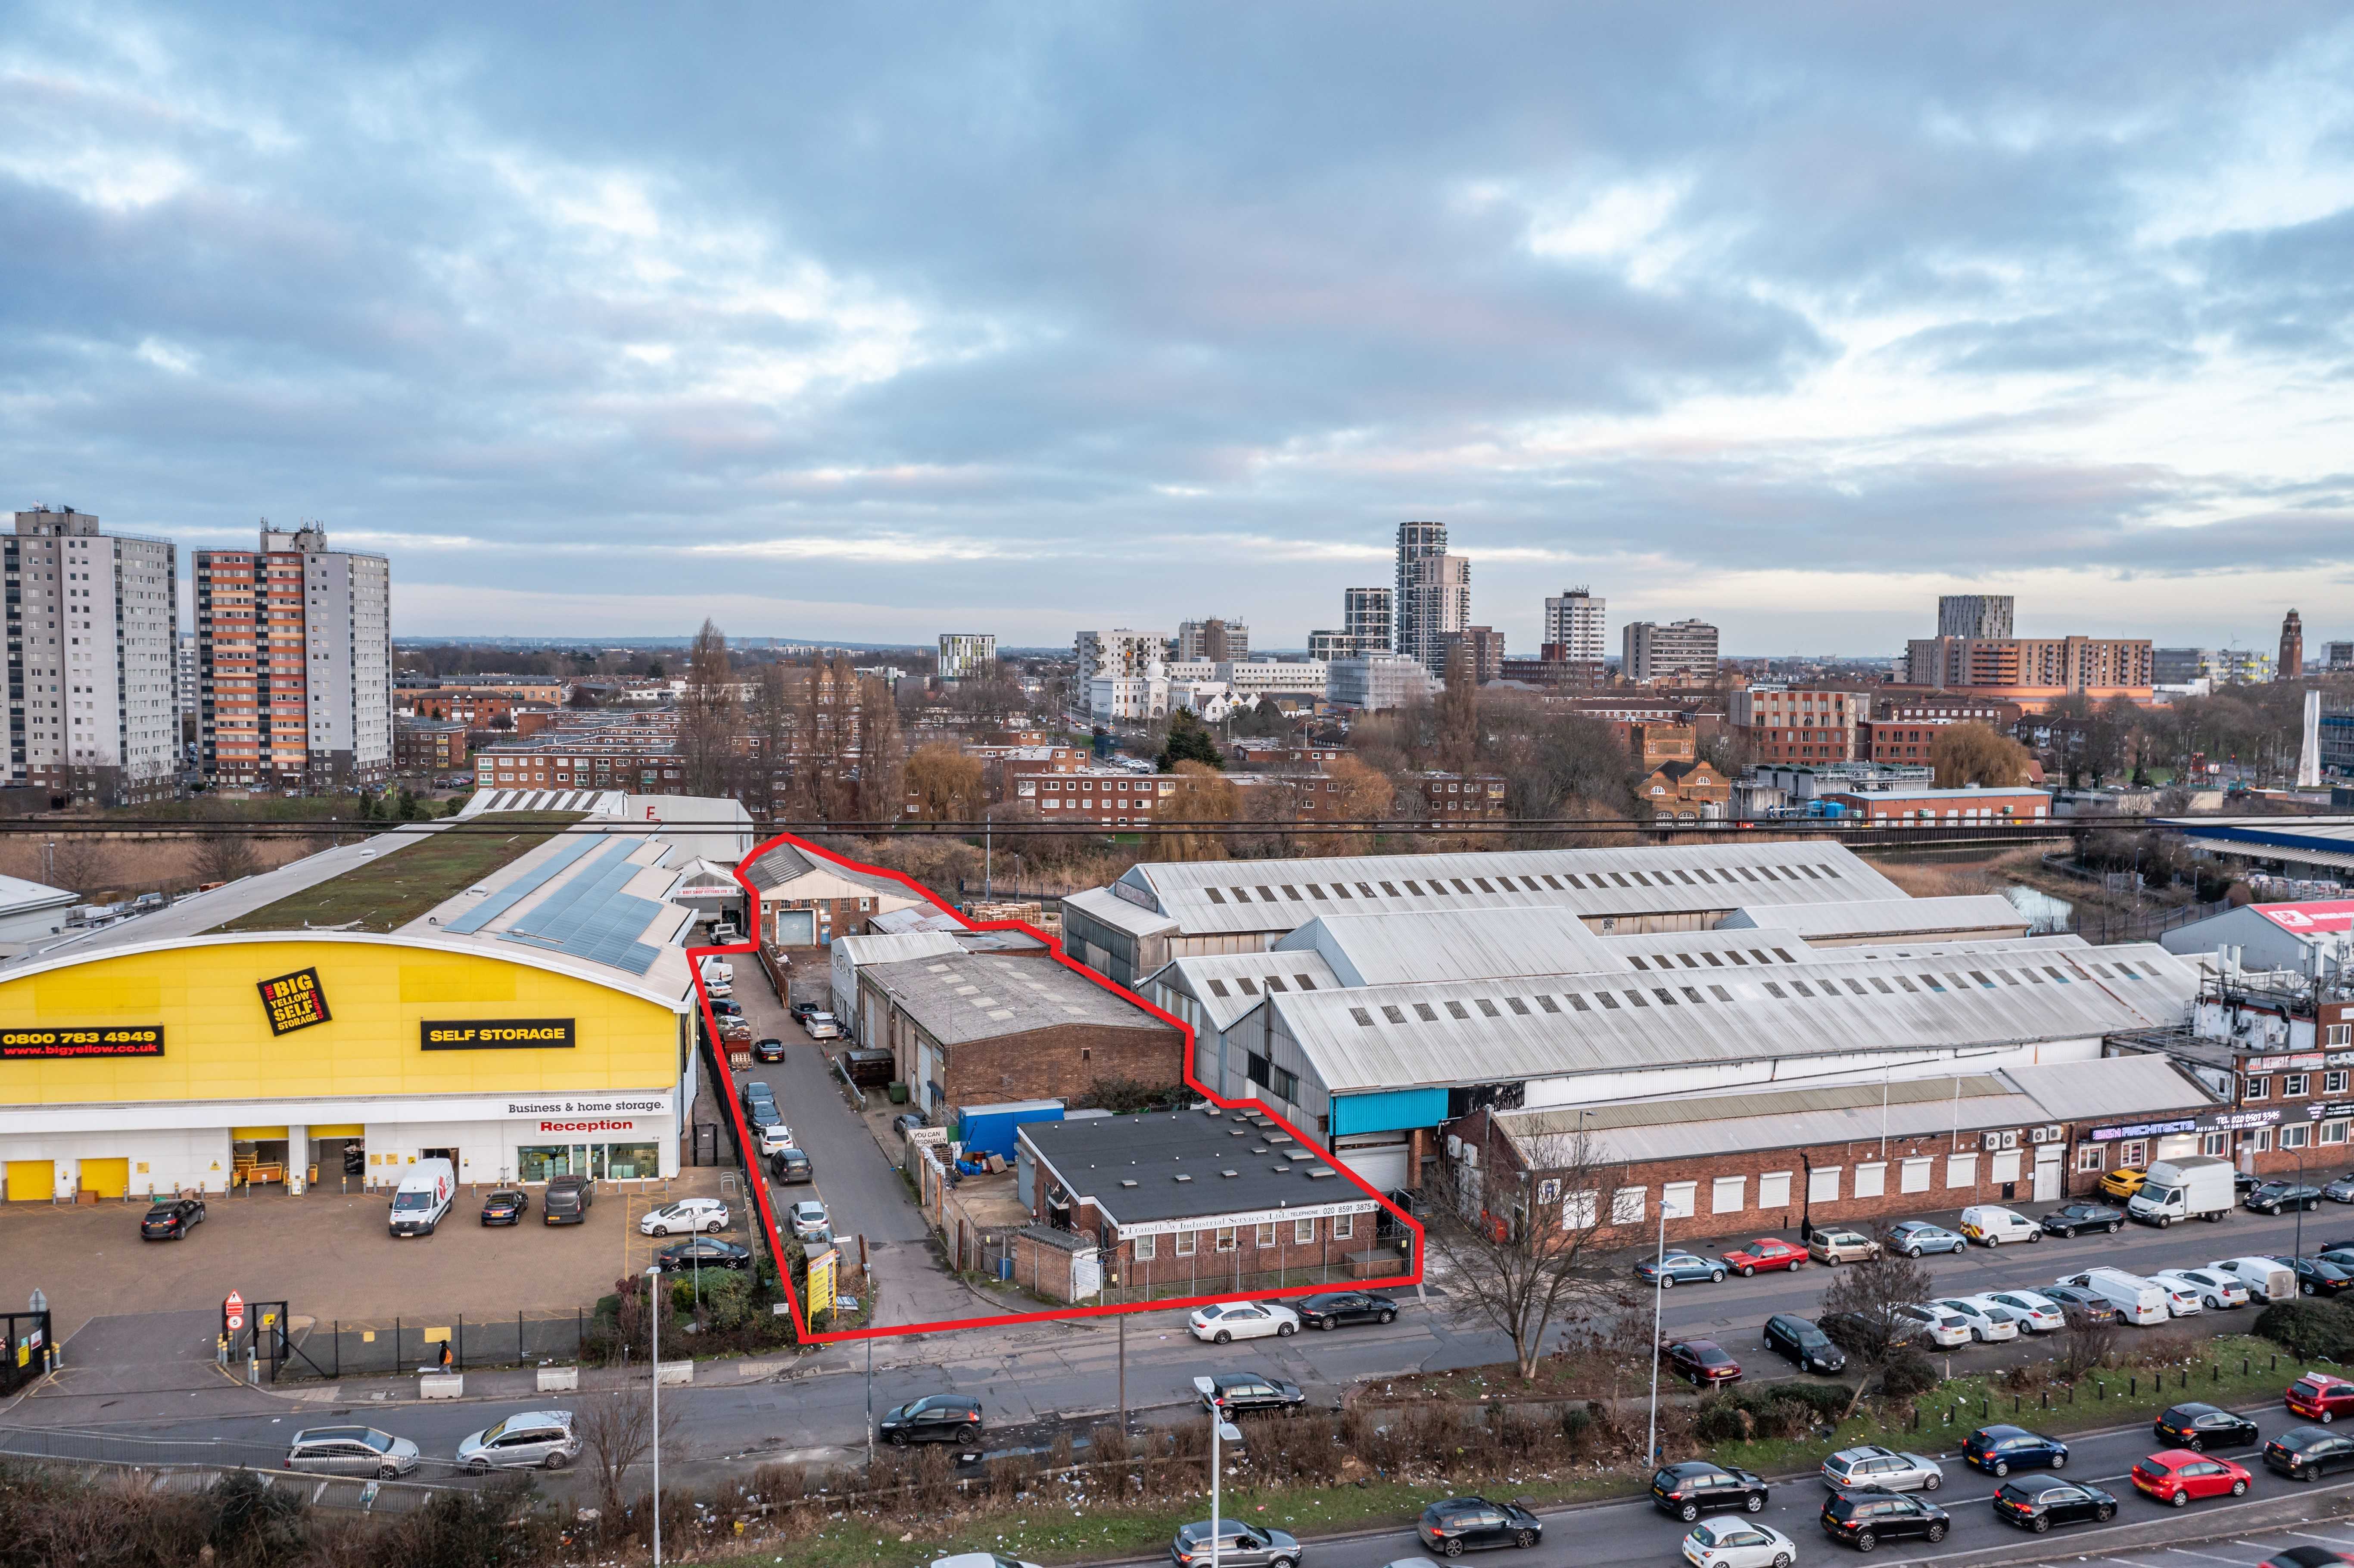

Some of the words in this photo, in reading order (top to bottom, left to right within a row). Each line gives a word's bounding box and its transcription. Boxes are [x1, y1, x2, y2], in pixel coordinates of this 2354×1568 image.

[264, 984, 276, 1000] THE
[273, 974, 314, 998] BIG
[270, 991, 309, 1009] YELLOW
[309, 989, 324, 1019] COMPANY
[274, 999, 313, 1021] SELF
[277, 1012, 318, 1030] STORAGE
[3, 1033, 56, 1045] 0800
[60, 1032, 100, 1043] 783
[104, 1031, 156, 1042] 4949
[430, 1030, 475, 1042] SELF
[480, 1028, 565, 1040] STORAGE
[3, 1044, 158, 1055] www.bigyellow.co.uk
[508, 1104, 561, 1113] Business
[565, 1103, 573, 1112] &
[578, 1102, 612, 1111] home
[616, 1101, 664, 1111] storage.
[540, 1120, 633, 1132] Reception
[2216, 1116, 2229, 1125] TEL
[2231, 1115, 2245, 1124] 020
[2093, 1128, 2122, 1140] SIGN
[2122, 1120, 2195, 1137] ARCHITECTS
[1323, 1207, 1335, 1215] 020
[1338, 1205, 1352, 1213] 8591
[1356, 1203, 1371, 1211] 3875
[1180, 1218, 1224, 1229] Industrial
[1228, 1214, 1264, 1224] Services
[1269, 1210, 1287, 1220] Ltd.
